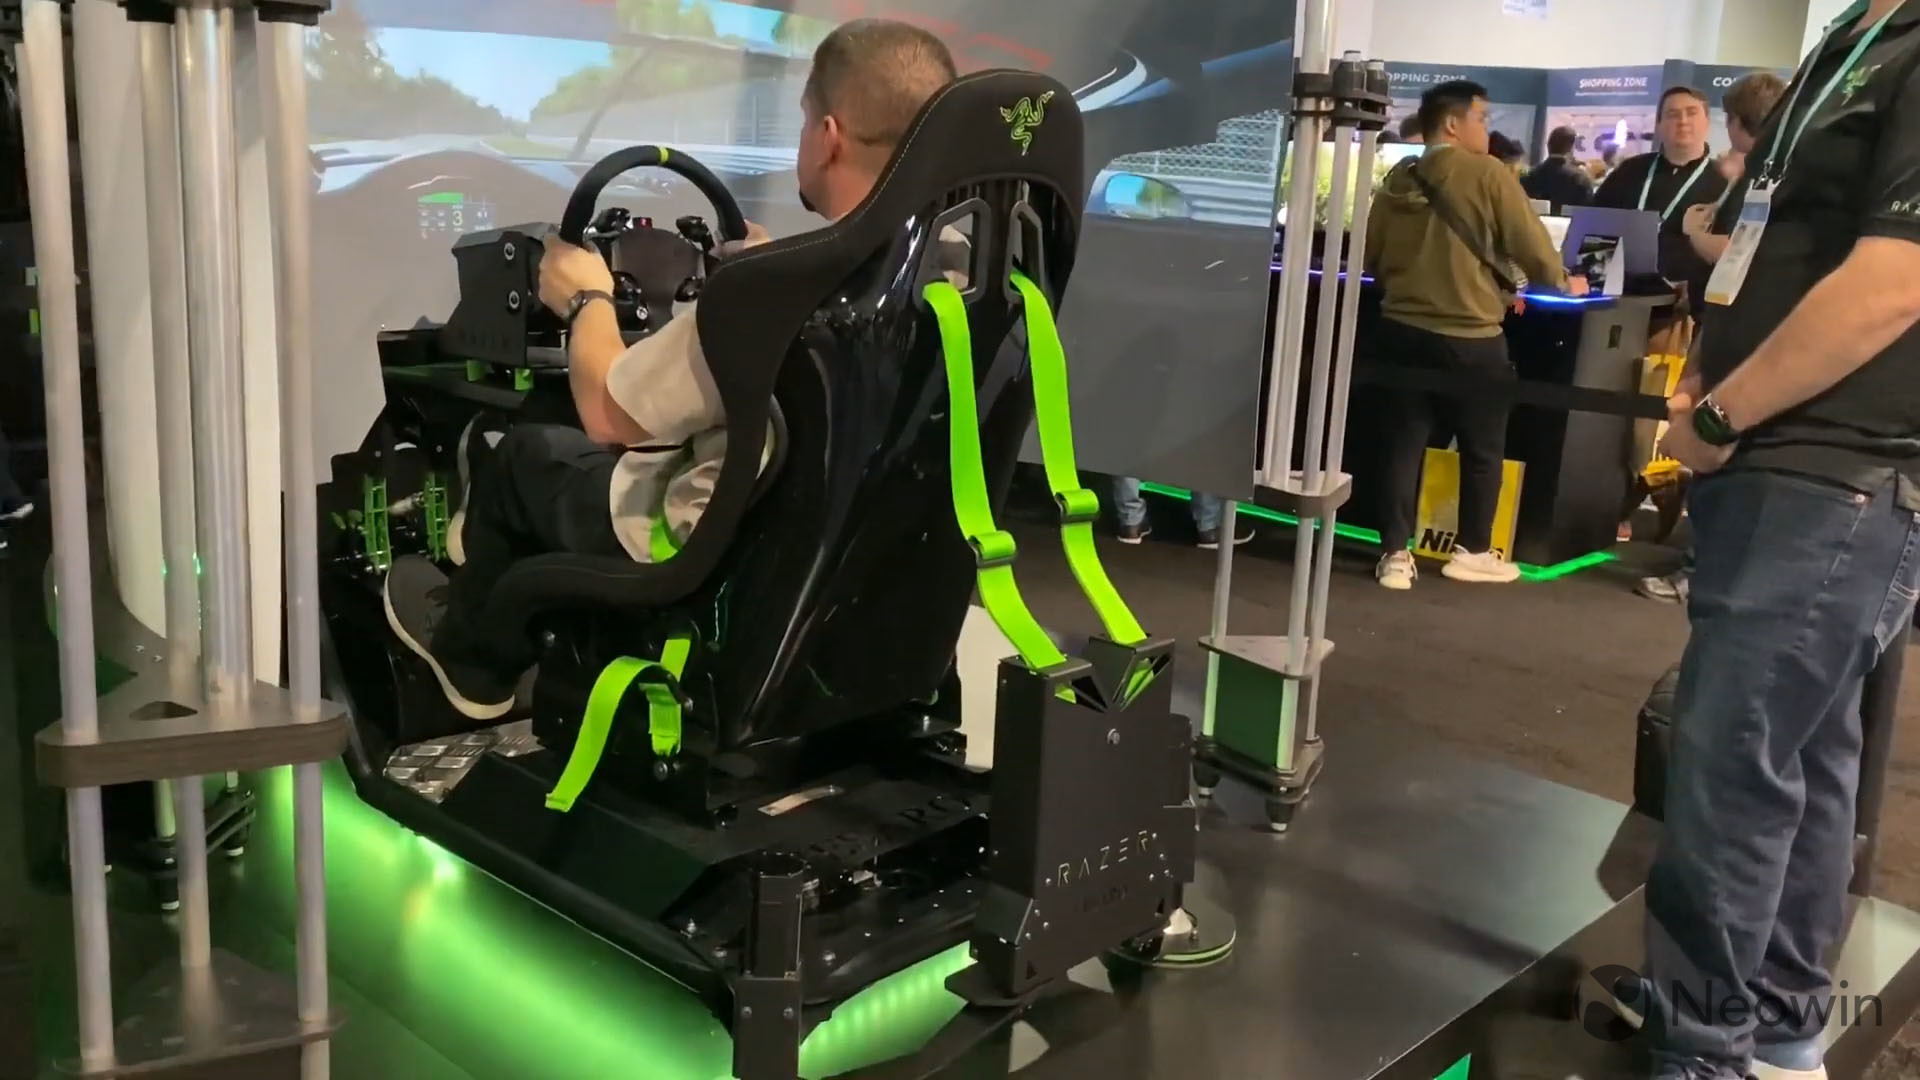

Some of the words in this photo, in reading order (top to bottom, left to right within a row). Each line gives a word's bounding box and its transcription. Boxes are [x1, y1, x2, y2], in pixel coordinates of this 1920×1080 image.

[1579, 77, 1622, 89] SHOPPING
[1623, 76, 1649, 87] ZONE
[1712, 76, 1737, 87] CO
[452, 210, 463, 226] 3
[1057, 829, 1148, 887] RAZER
